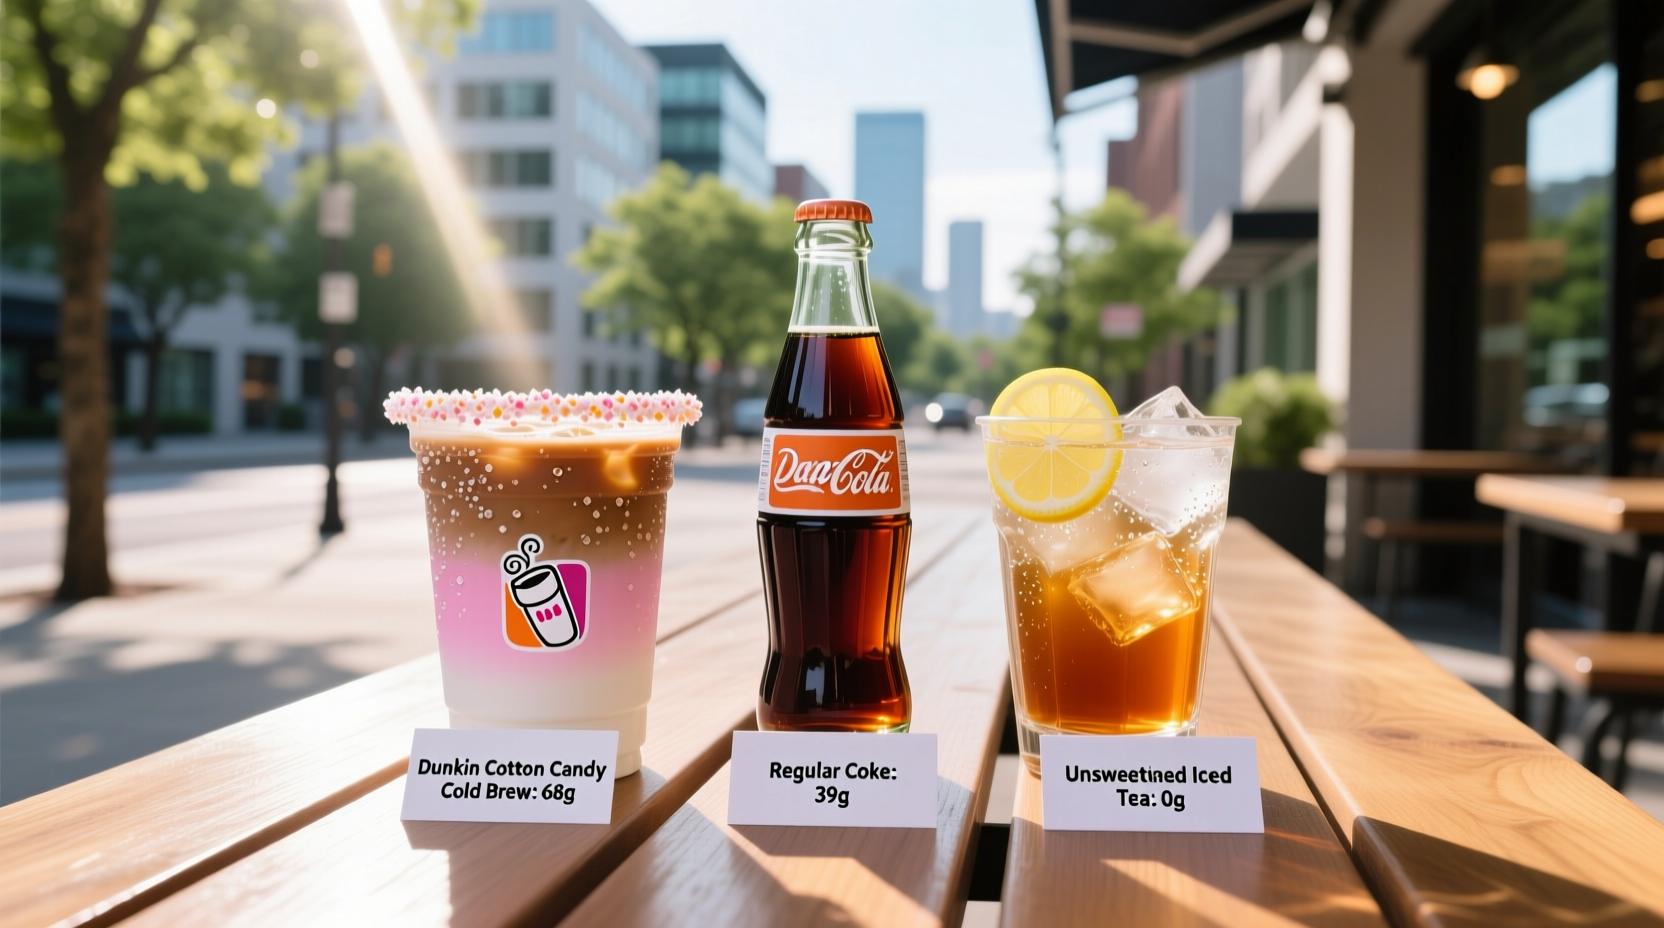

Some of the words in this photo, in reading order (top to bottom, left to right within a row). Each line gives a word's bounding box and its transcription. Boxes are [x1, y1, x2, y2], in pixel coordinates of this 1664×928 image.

[417, 757, 480, 776] Dunkin
[484, 759, 545, 777] Cotton
[549, 759, 607, 783] Candy
[769, 761, 841, 784] Regular
[844, 761, 898, 783] Coke:
[1192, 765, 1232, 784] Iced
[440, 781, 482, 799] Cold
[485, 782, 538, 800] Brew:
[541, 783, 576, 805] 68g
[814, 785, 850, 809] 39g
[1115, 788, 1158, 807] Tea:
[1160, 789, 1186, 813] 0g
